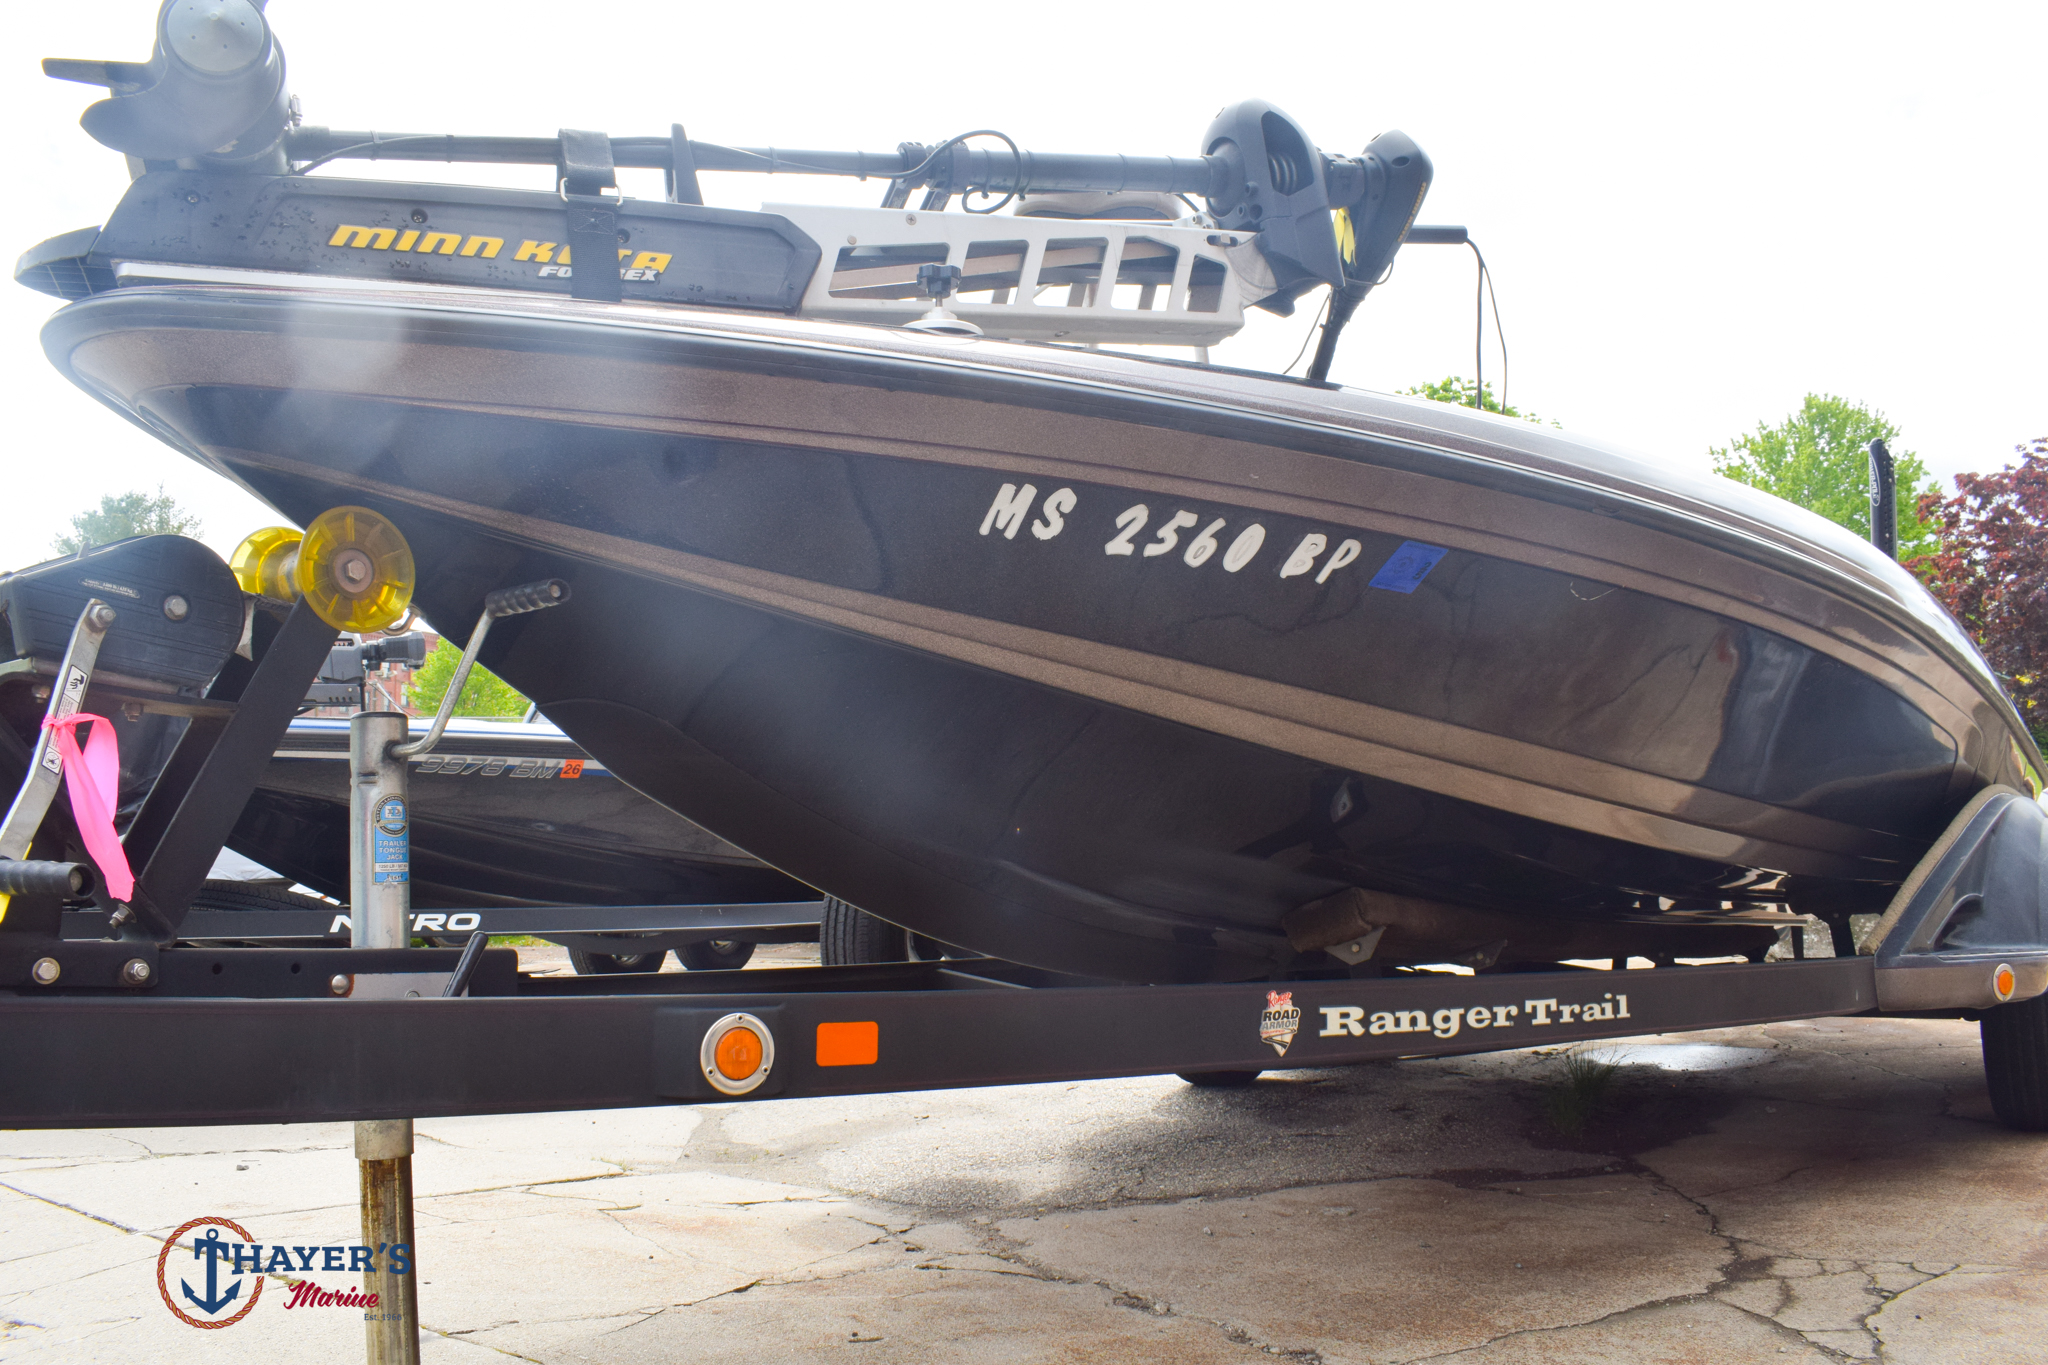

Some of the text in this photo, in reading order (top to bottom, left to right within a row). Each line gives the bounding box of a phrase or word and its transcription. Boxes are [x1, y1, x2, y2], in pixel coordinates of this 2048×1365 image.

[537, 266, 660, 282] FOEX
[978, 482, 1363, 584] MS 2560 BP
[415, 755, 561, 779] 9978 BM
[562, 763, 581, 776] 26
[329, 913, 481, 933] NRO
[1263, 1009, 1300, 1021] ROAD
[1318, 992, 1632, 1039] Ranger Trail
[1262, 1020, 1298, 1030] ARMOR
